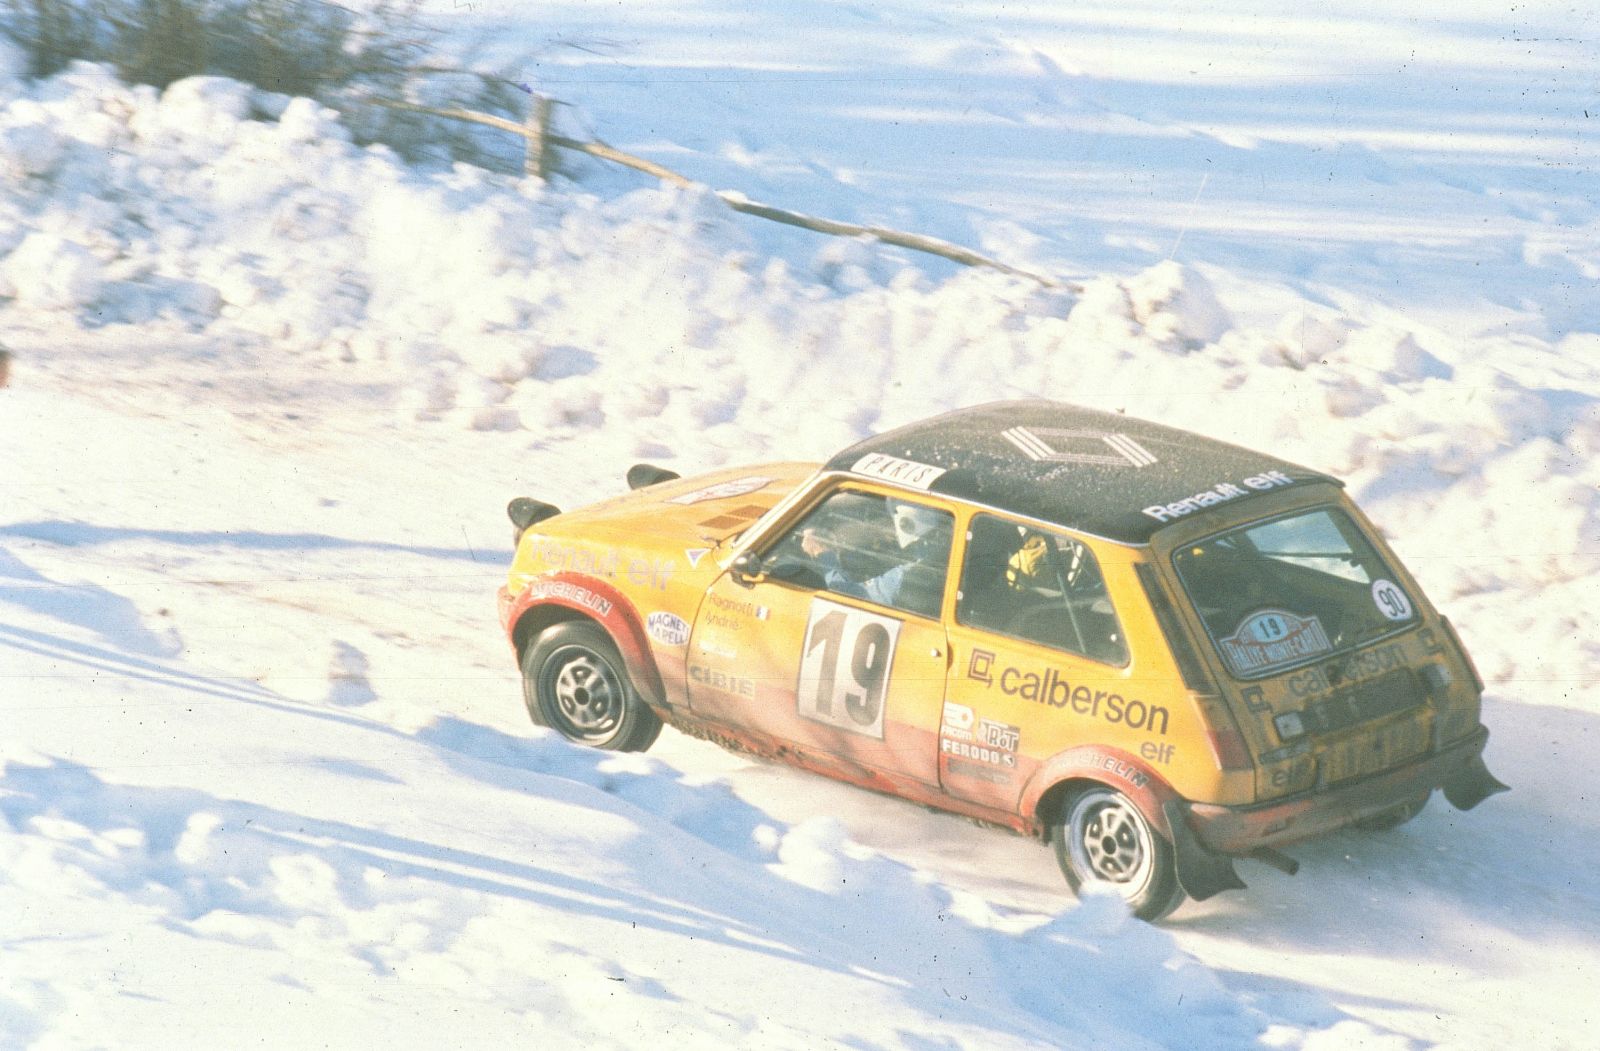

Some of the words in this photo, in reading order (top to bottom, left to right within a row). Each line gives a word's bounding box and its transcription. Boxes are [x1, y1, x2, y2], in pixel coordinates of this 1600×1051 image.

[863, 456, 933, 483] PARIS
[1141, 483, 1249, 522] Renault
[1243, 470, 1294, 489] elf
[628, 557, 676, 591] elf
[1377, 587, 1406, 616] 90
[1258, 618, 1282, 639] 19
[806, 610, 891, 726] 19
[999, 667, 1170, 735] calberson
[942, 738, 1000, 765] FERODO
[1140, 741, 1176, 765] elf
